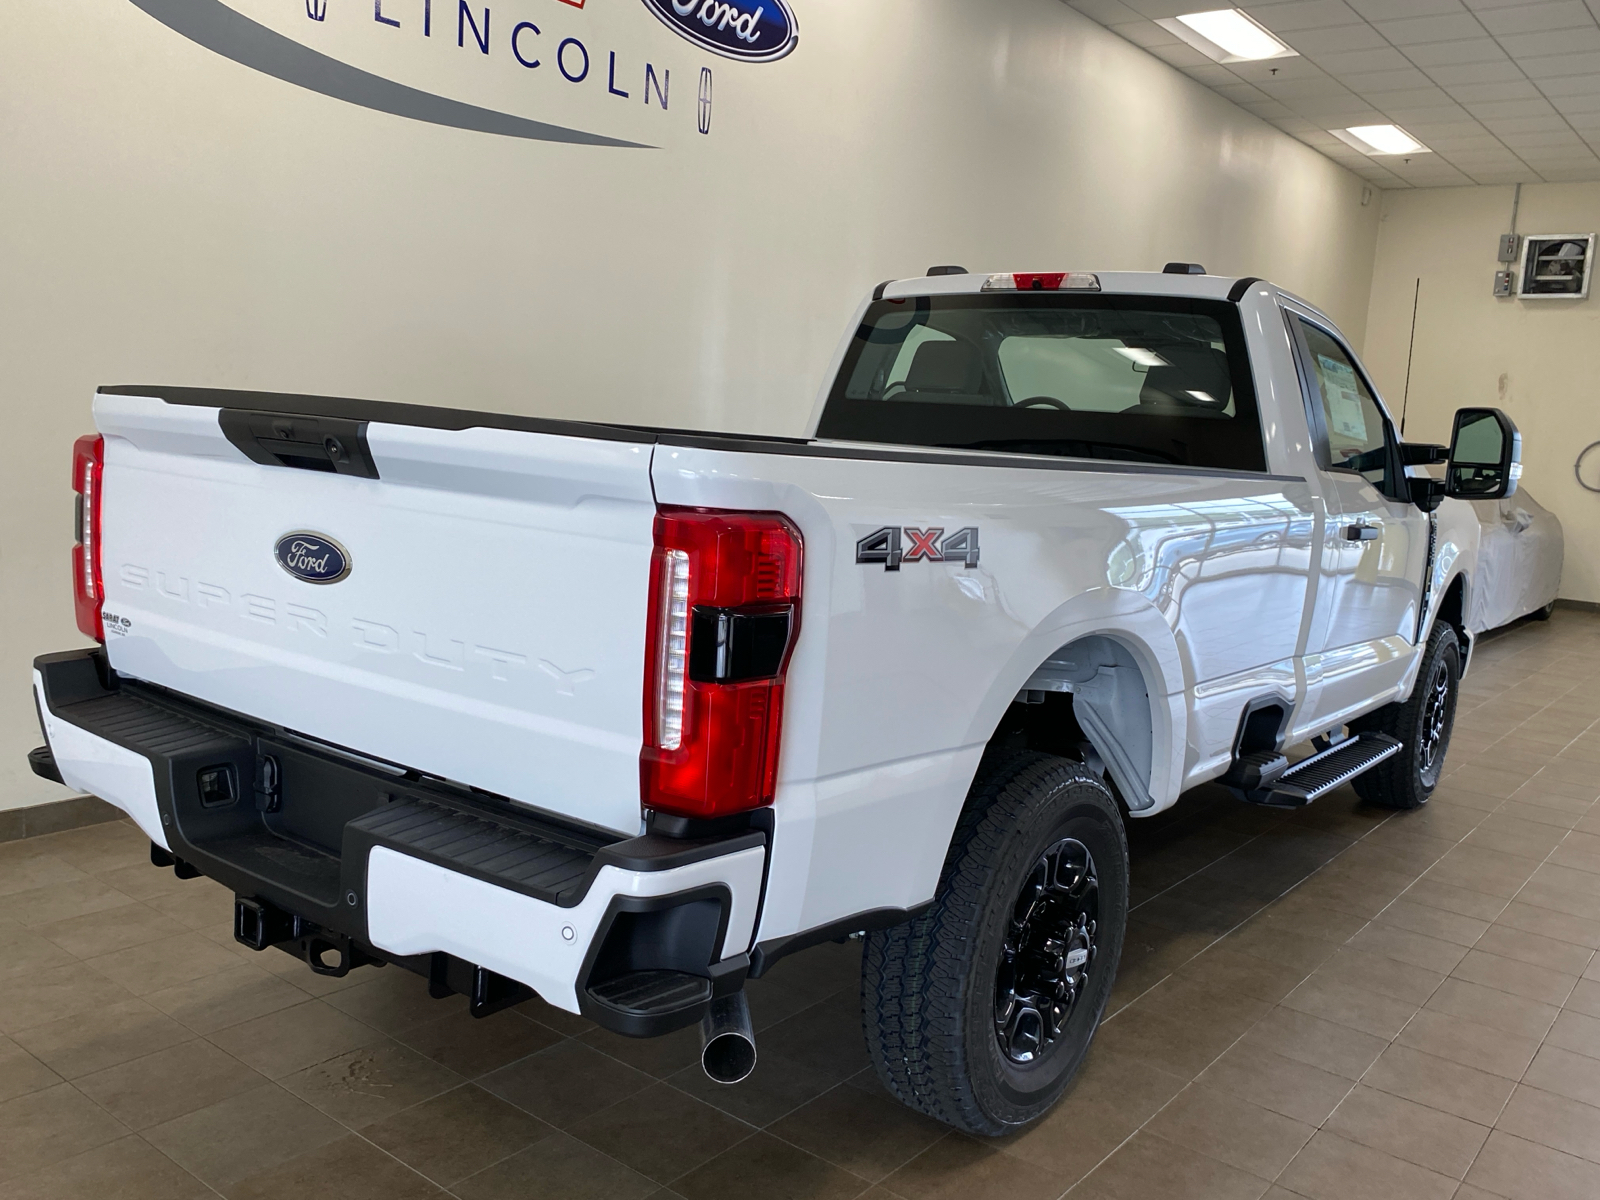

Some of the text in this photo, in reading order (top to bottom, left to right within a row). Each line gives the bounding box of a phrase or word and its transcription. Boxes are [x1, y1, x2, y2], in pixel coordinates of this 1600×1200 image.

[287, 540, 330, 573] Ford
[107, 622, 128, 634] LINCOLN
[121, 563, 596, 696] SUPER DUTY
